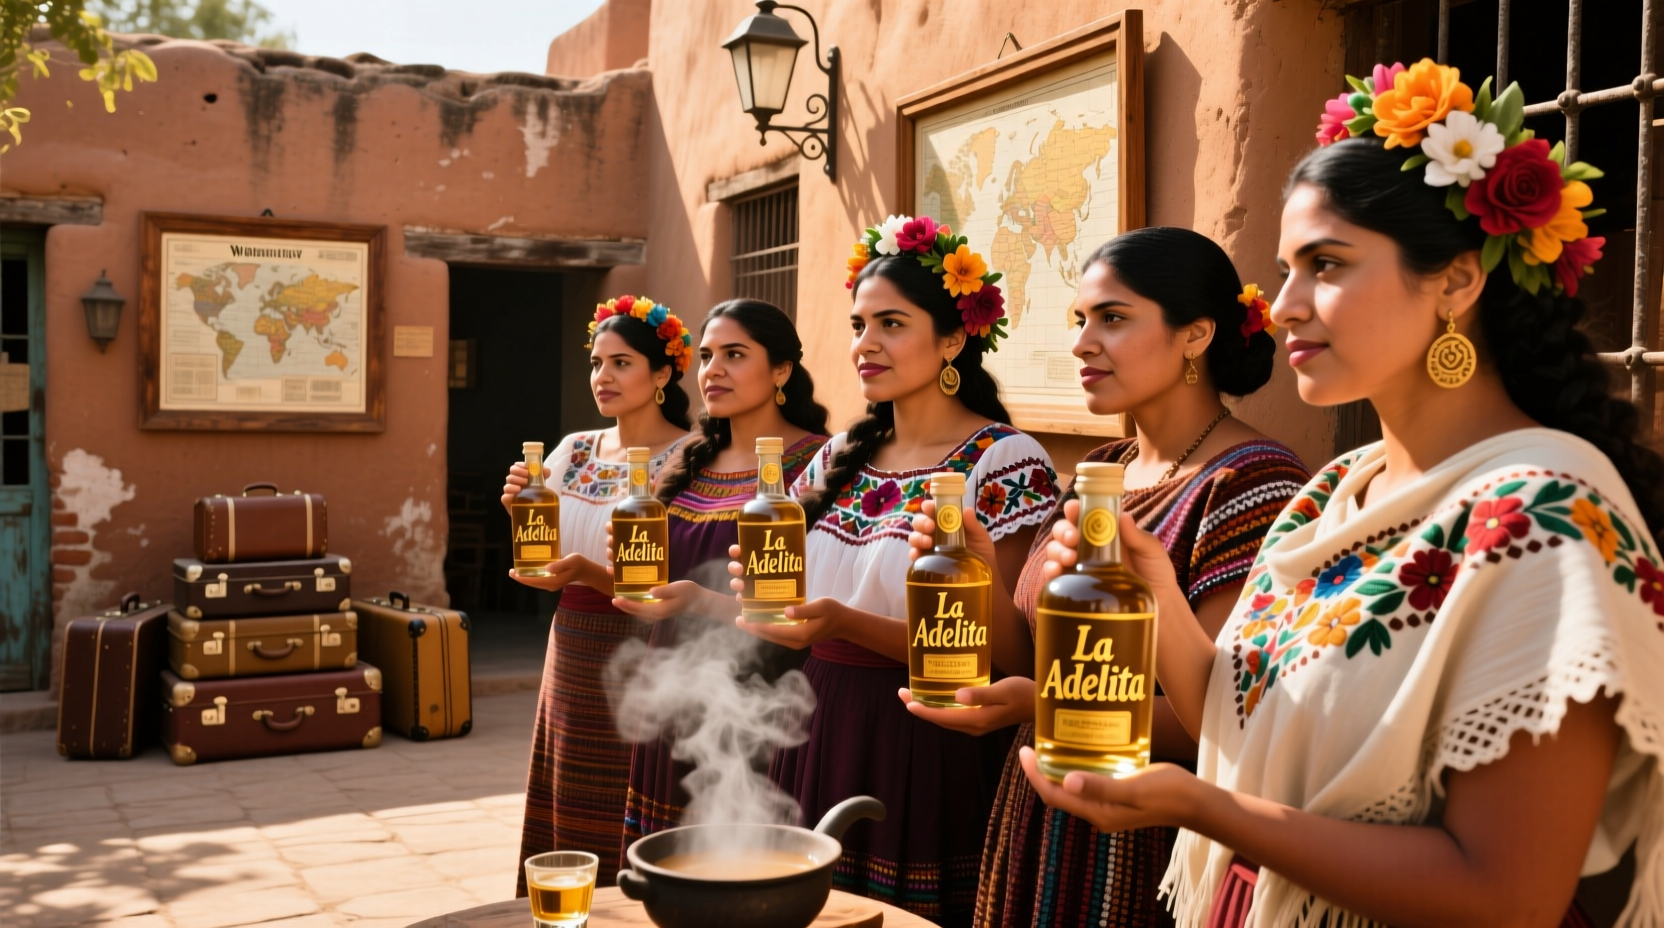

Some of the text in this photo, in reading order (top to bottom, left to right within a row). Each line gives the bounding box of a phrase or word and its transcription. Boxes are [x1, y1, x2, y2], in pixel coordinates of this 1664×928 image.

[527, 509, 544, 525] La
[629, 525, 649, 542] La
[763, 530, 786, 550] La
[746, 550, 803, 575] Adelita
[934, 592, 964, 618] La
[912, 617, 987, 647] Adelita
[1071, 625, 1114, 662] La
[1040, 659, 1146, 702] Adelita
